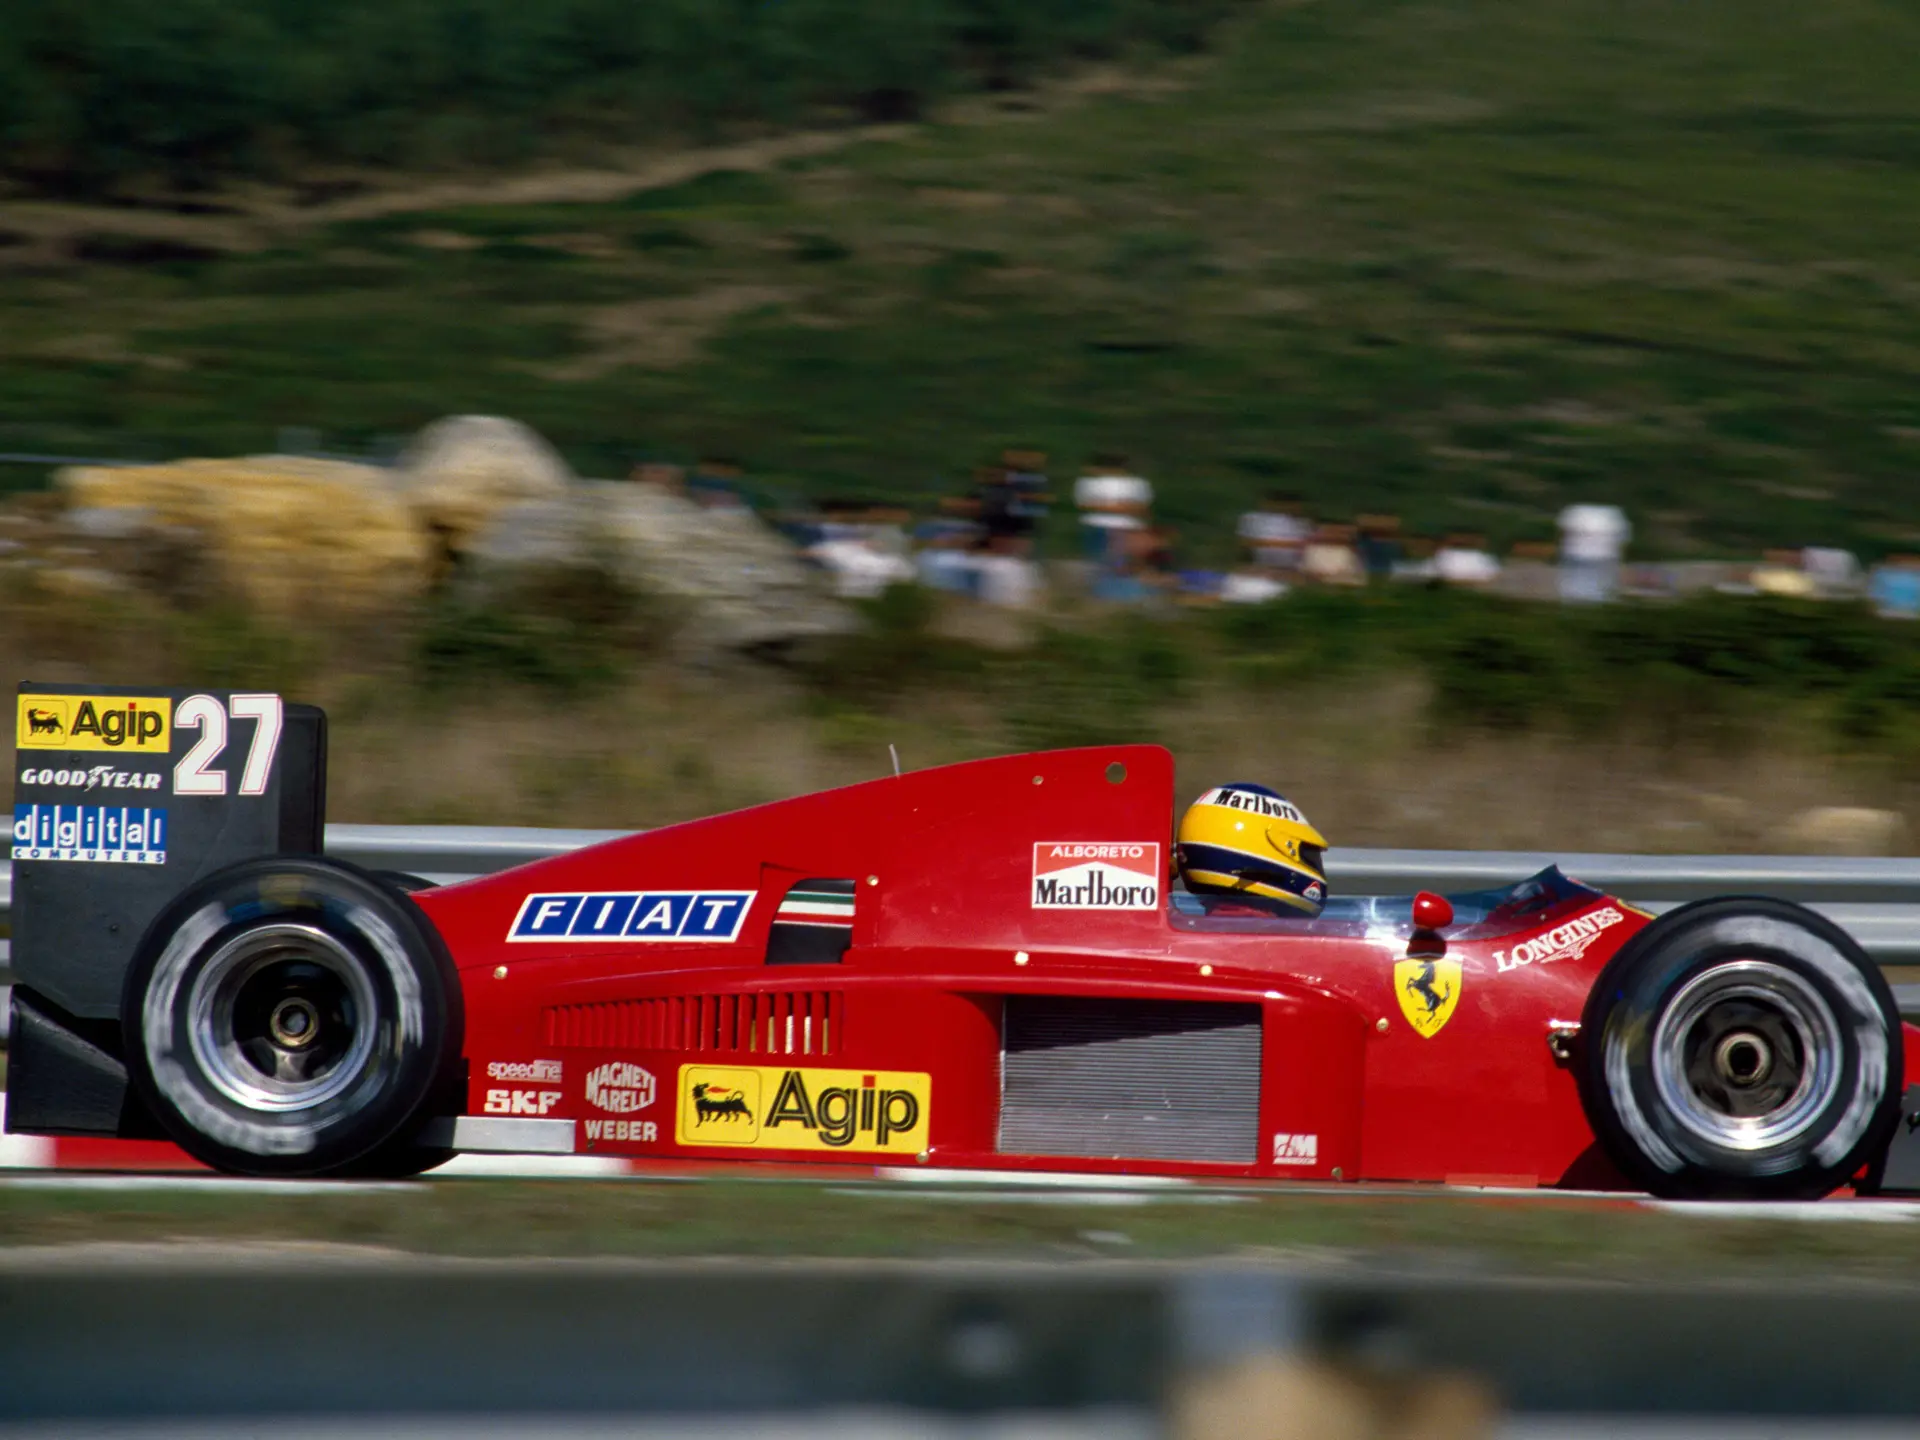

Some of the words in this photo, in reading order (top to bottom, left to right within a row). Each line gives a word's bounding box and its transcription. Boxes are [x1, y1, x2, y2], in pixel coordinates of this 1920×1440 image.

[70, 700, 164, 746] Agip
[173, 693, 284, 796] 27
[1214, 789, 1300, 822] Marlboro
[14, 815, 162, 845] digital
[14, 849, 164, 863] COMPUTERS
[1050, 845, 1144, 859] ALBORETO
[1034, 869, 1157, 907] Marlboro
[531, 900, 738, 930] FIAT
[1492, 906, 1625, 973] LONGINES
[484, 1089, 563, 1114] SKF
[764, 1071, 920, 1147] Agip
[584, 1119, 657, 1142] WEBER
